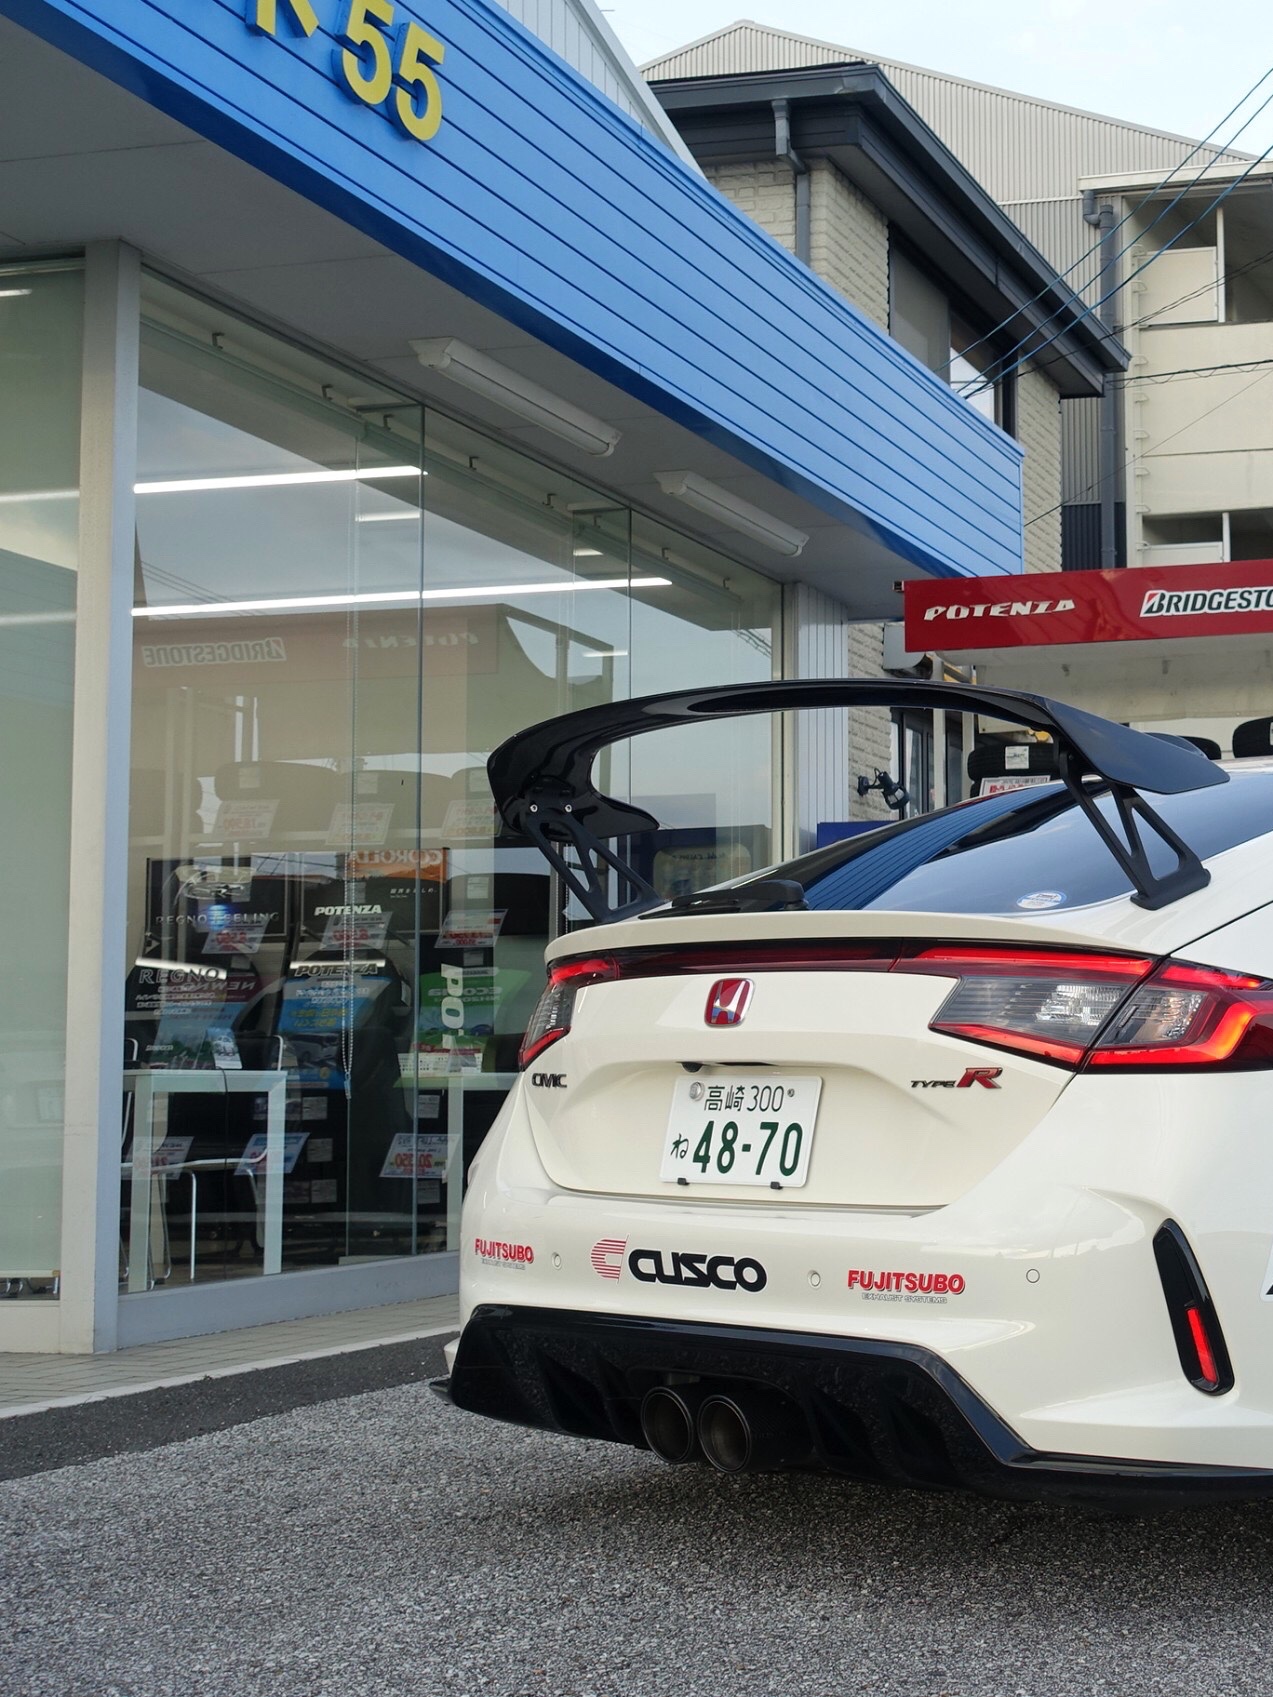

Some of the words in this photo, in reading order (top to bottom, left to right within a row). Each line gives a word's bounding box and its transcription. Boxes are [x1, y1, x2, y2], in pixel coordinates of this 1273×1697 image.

[342, 0, 445, 141] 55
[923, 599, 1076, 621] POTENZA
[155, 914, 207, 925] REGNO
[314, 905, 382, 916] POTENZA
[139, 967, 220, 984] REGNO
[532, 1073, 567, 1088] CIVIC
[911, 1080, 956, 1088] TYPE
[956, 1067, 1003, 1089] R
[704, 1085, 745, 1111] 高崎
[746, 1085, 784, 1112] 300
[670, 1133, 689, 1159] ね
[692, 1120, 803, 1176] 48-70
[475, 1238, 534, 1264] FUJITSUBO
[628, 1248, 767, 1292] CUSCO
[847, 1269, 966, 1295] FUJITSUBO
